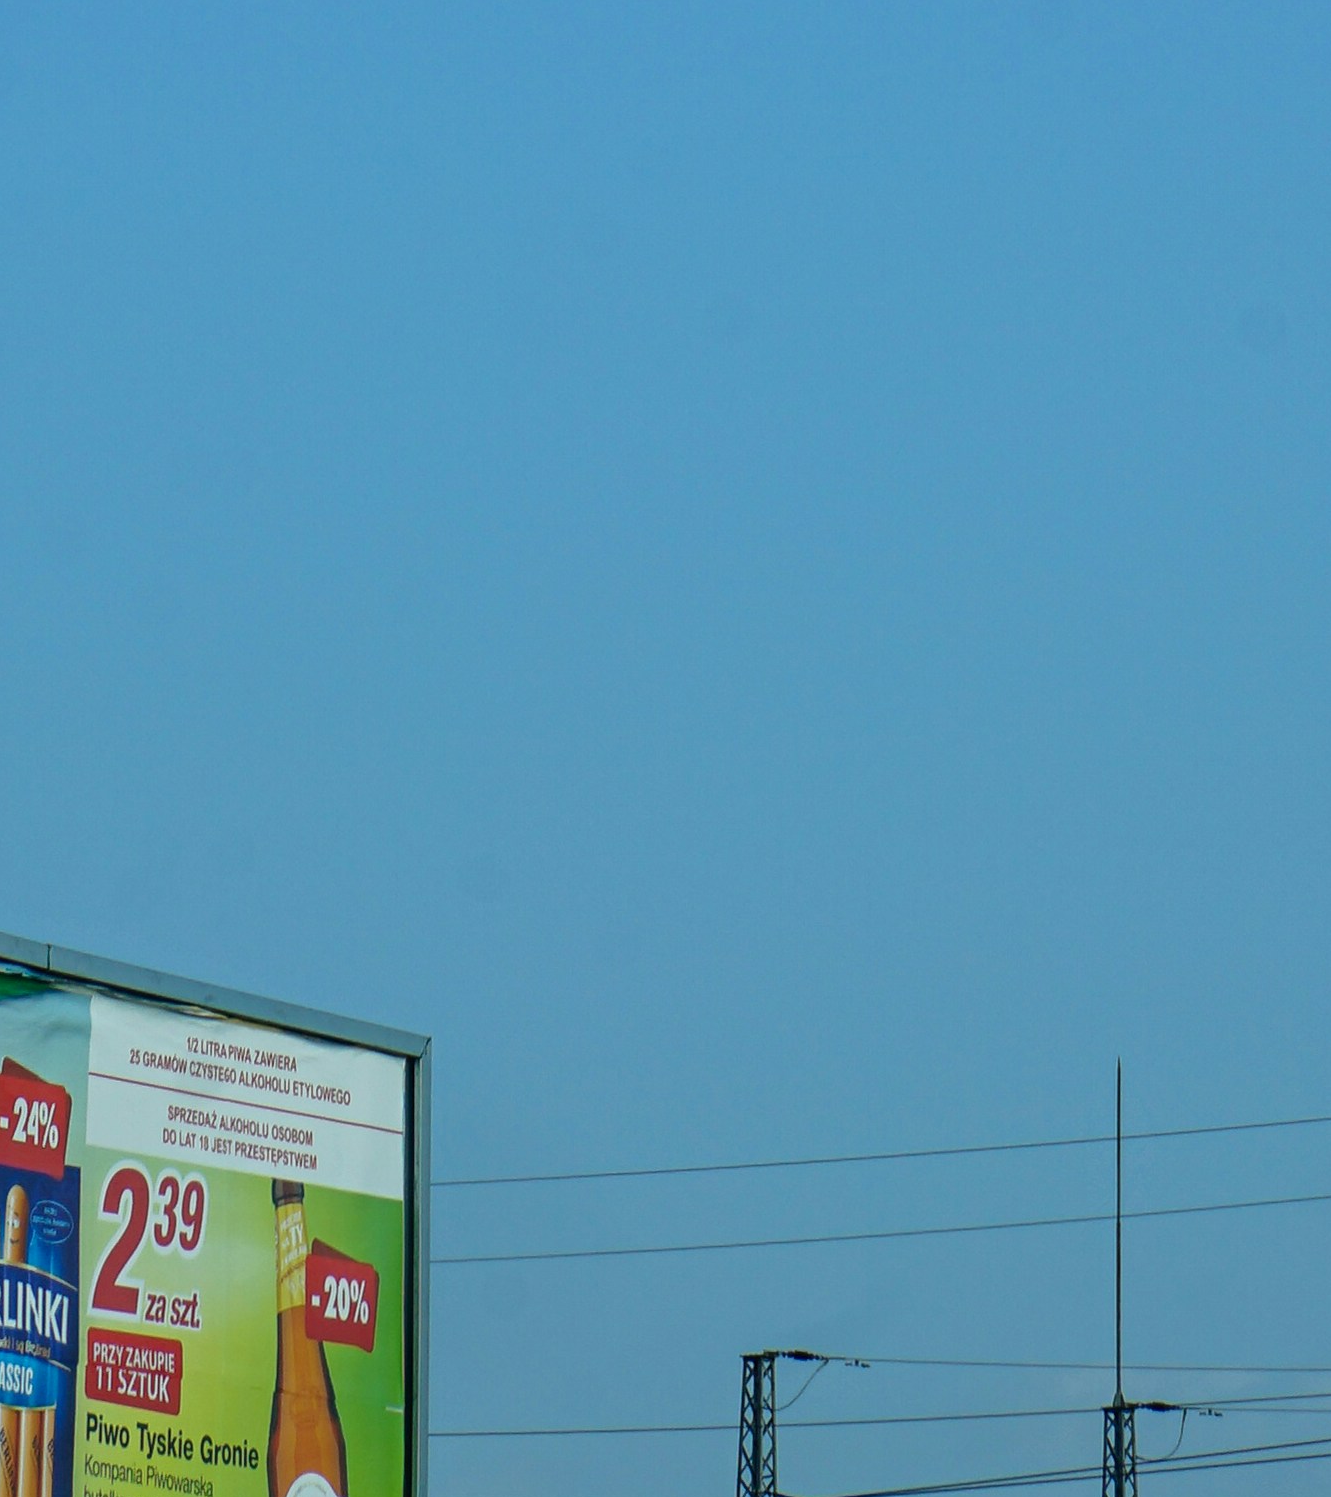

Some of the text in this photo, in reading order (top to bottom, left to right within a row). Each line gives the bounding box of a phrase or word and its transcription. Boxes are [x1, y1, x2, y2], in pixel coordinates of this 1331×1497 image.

[186, 1036, 298, 1073] 1/2 LITRA PIWA ZAWIERA
[130, 1049, 351, 1106] 25 GRAMÓW CZYSTEGO ALKOHOLU ETYLOWEGO
[167, 1104, 313, 1146] SPRZEDAŻ ALKOHOLU OSOBOM
[162, 1127, 317, 1170] DO LAT 18 JEST PRZESTĘPSTWEM
[145, 1292, 200, 1329] za szt.
[93, 1342, 175, 1374] PRZY ZAKUPIE
[96, 1366, 170, 1403] 11 SZTUK
[86, 1412, 259, 1469] Piwo Tyskie Gronie
[85, 1454, 214, 1497] Kompania Piwowarska
